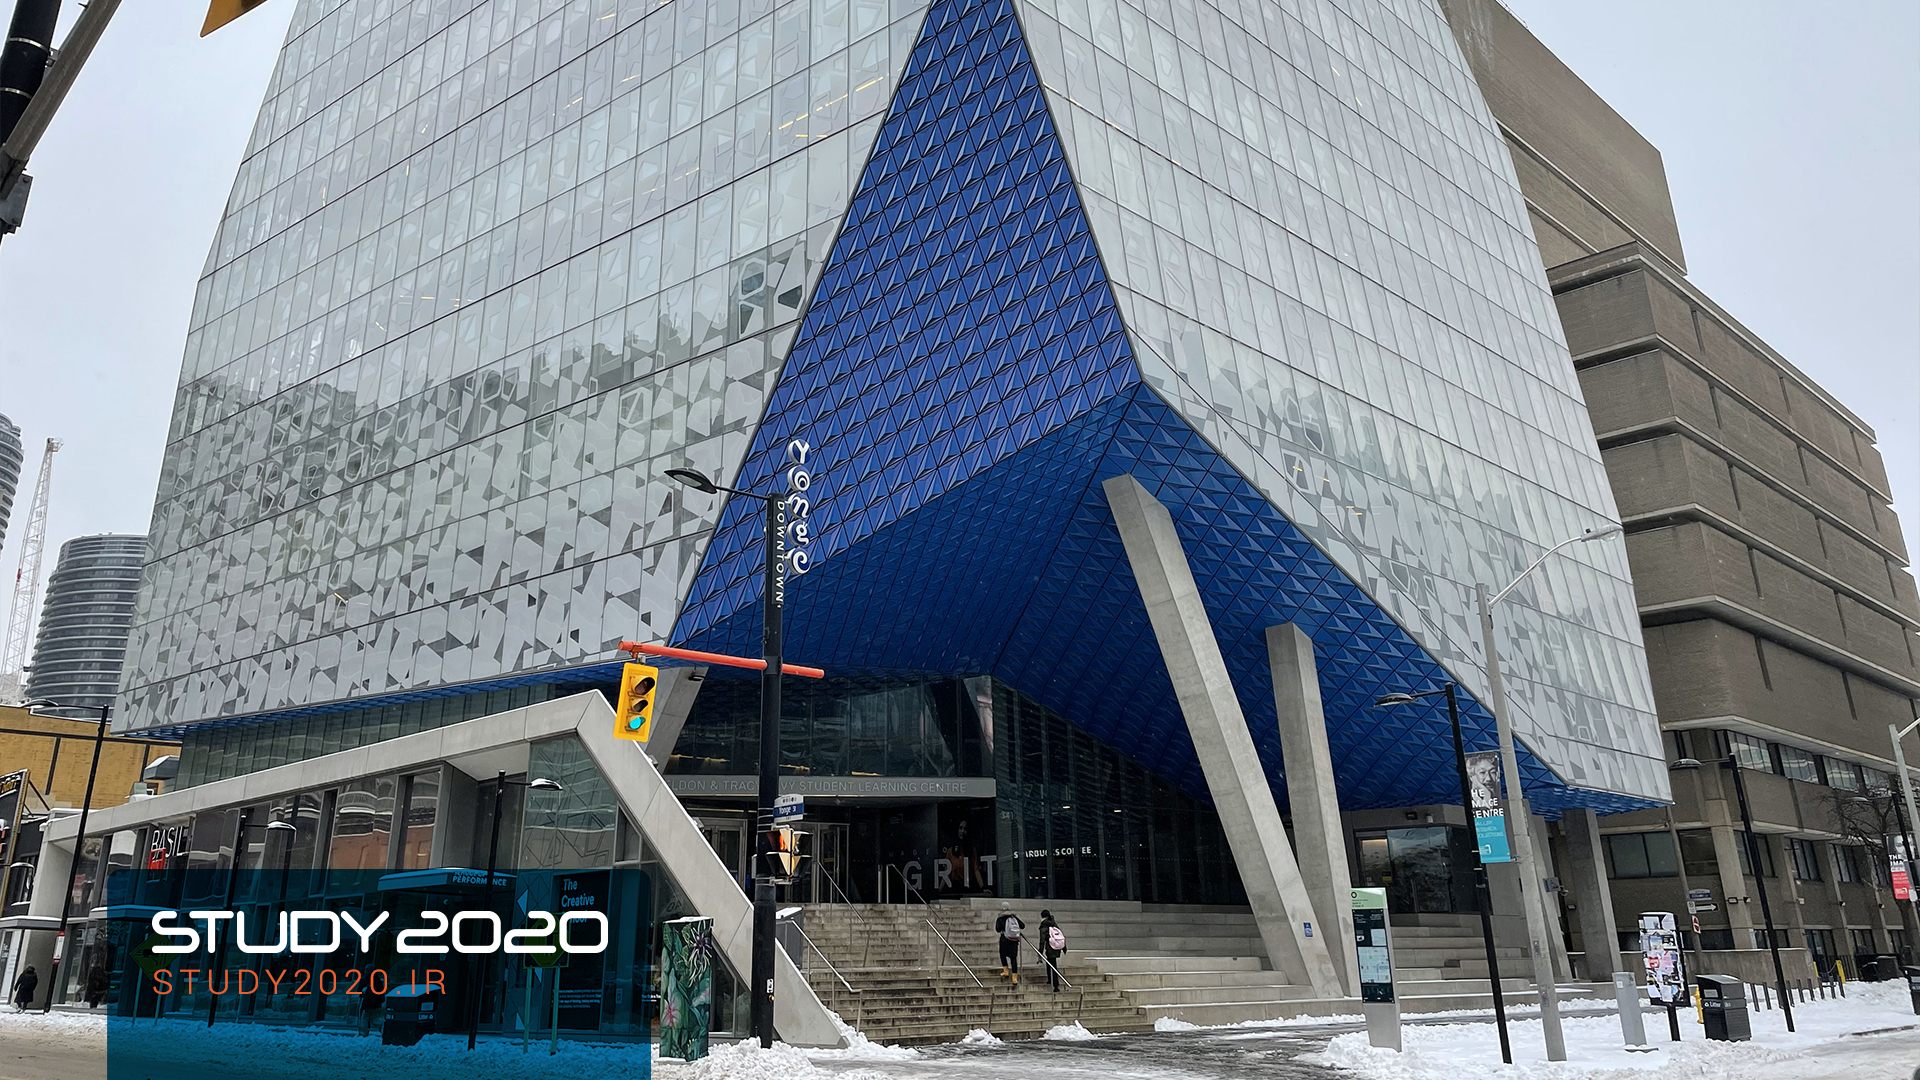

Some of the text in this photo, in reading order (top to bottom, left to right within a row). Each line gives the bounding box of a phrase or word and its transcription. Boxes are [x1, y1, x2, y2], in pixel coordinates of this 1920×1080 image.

[775, 501, 786, 602] DOWNTOWN
[667, 780, 705, 792] LDON
[710, 780, 719, 791] &
[780, 781, 796, 791] VY
[800, 781, 854, 792] STUDENT
[858, 781, 917, 792] LEARNING
[920, 782, 966, 793] CENTRE
[1471, 788, 1485, 797] HE
[1471, 797, 1498, 809] MAGE
[1473, 808, 1504, 819] ENTRE
[1013, 846, 1092, 859] SARBUS COEE
[902, 855, 997, 891] GRIT
[452, 875, 507, 887] PERFORMNCE
[562, 878, 578, 891] The
[561, 892, 595, 908] Creative
